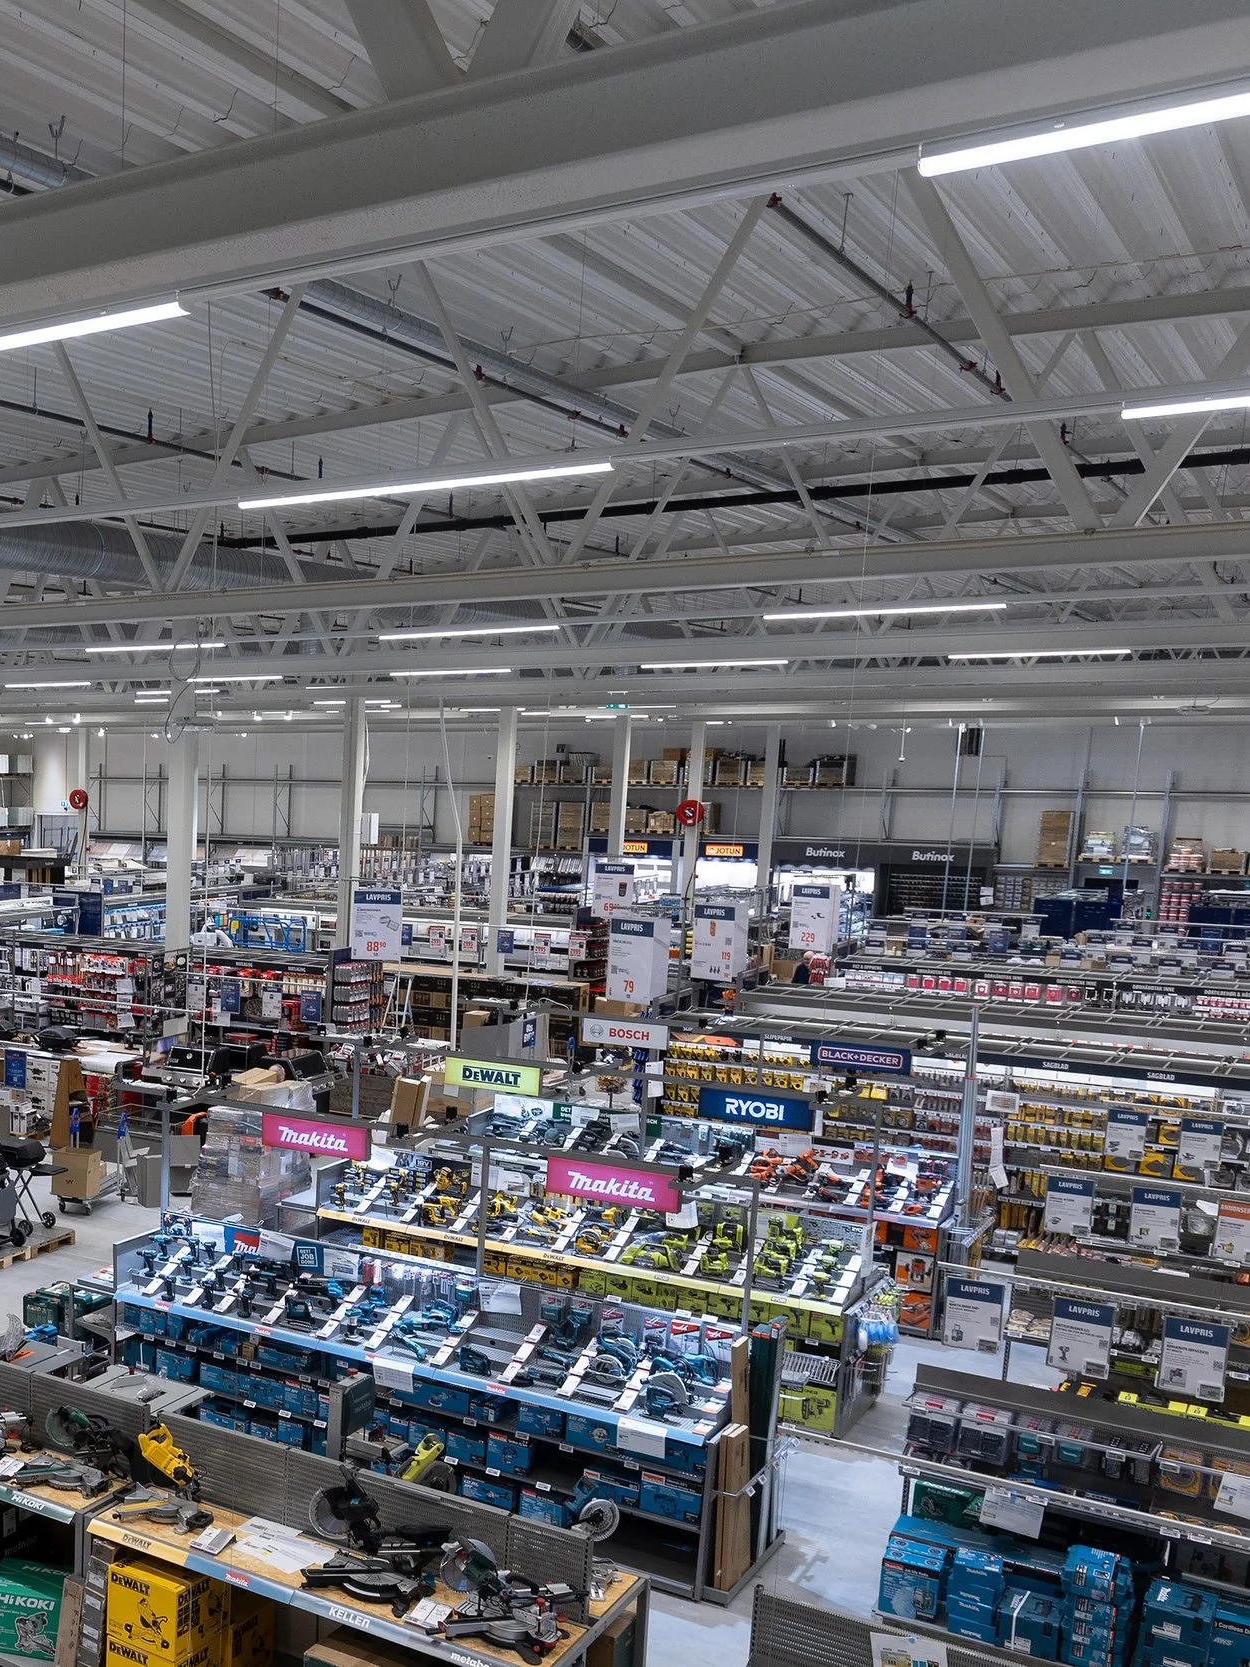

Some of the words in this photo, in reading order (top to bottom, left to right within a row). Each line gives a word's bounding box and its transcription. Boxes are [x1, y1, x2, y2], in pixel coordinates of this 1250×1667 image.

[716, 846, 740, 855] JOTUN
[806, 847, 846, 858] Butinox
[912, 850, 954, 862] Butinox
[802, 888, 822, 896] LAVPRIS
[604, 902, 614, 912] 69
[704, 908, 726, 916] LAVPRIS
[620, 922, 644, 932] LAVPRIS
[801, 932, 815, 943] 229
[721, 951, 730, 960] 119
[624, 980, 634, 992] 79
[609, 1028, 650, 1041] BOSCH
[822, 1050, 899, 1065] BLACK+DECKER
[1042, 1061, 1069, 1070] SAGBLAD
[1147, 1072, 1176, 1082] SAGBLAD
[726, 1098, 784, 1120] RYOBI
[1192, 1122, 1214, 1130] LAVPRIS
[278, 1126, 348, 1152] makita
[567, 1171, 656, 1202] makita
[1058, 1182, 1082, 1190] LAVPRIS
[1144, 1193, 1170, 1201] LAVPRIS
[960, 1284, 990, 1295] LAVPRIS
[1068, 1305, 1100, 1318] LAVPRIS
[1180, 1325, 1214, 1338] LAVPRIS
[12, 1494, 46, 1511] HiKOKI
[328, 1606, 371, 1628] KELLEN
[1218, 1621, 1244, 1633] Cordless
